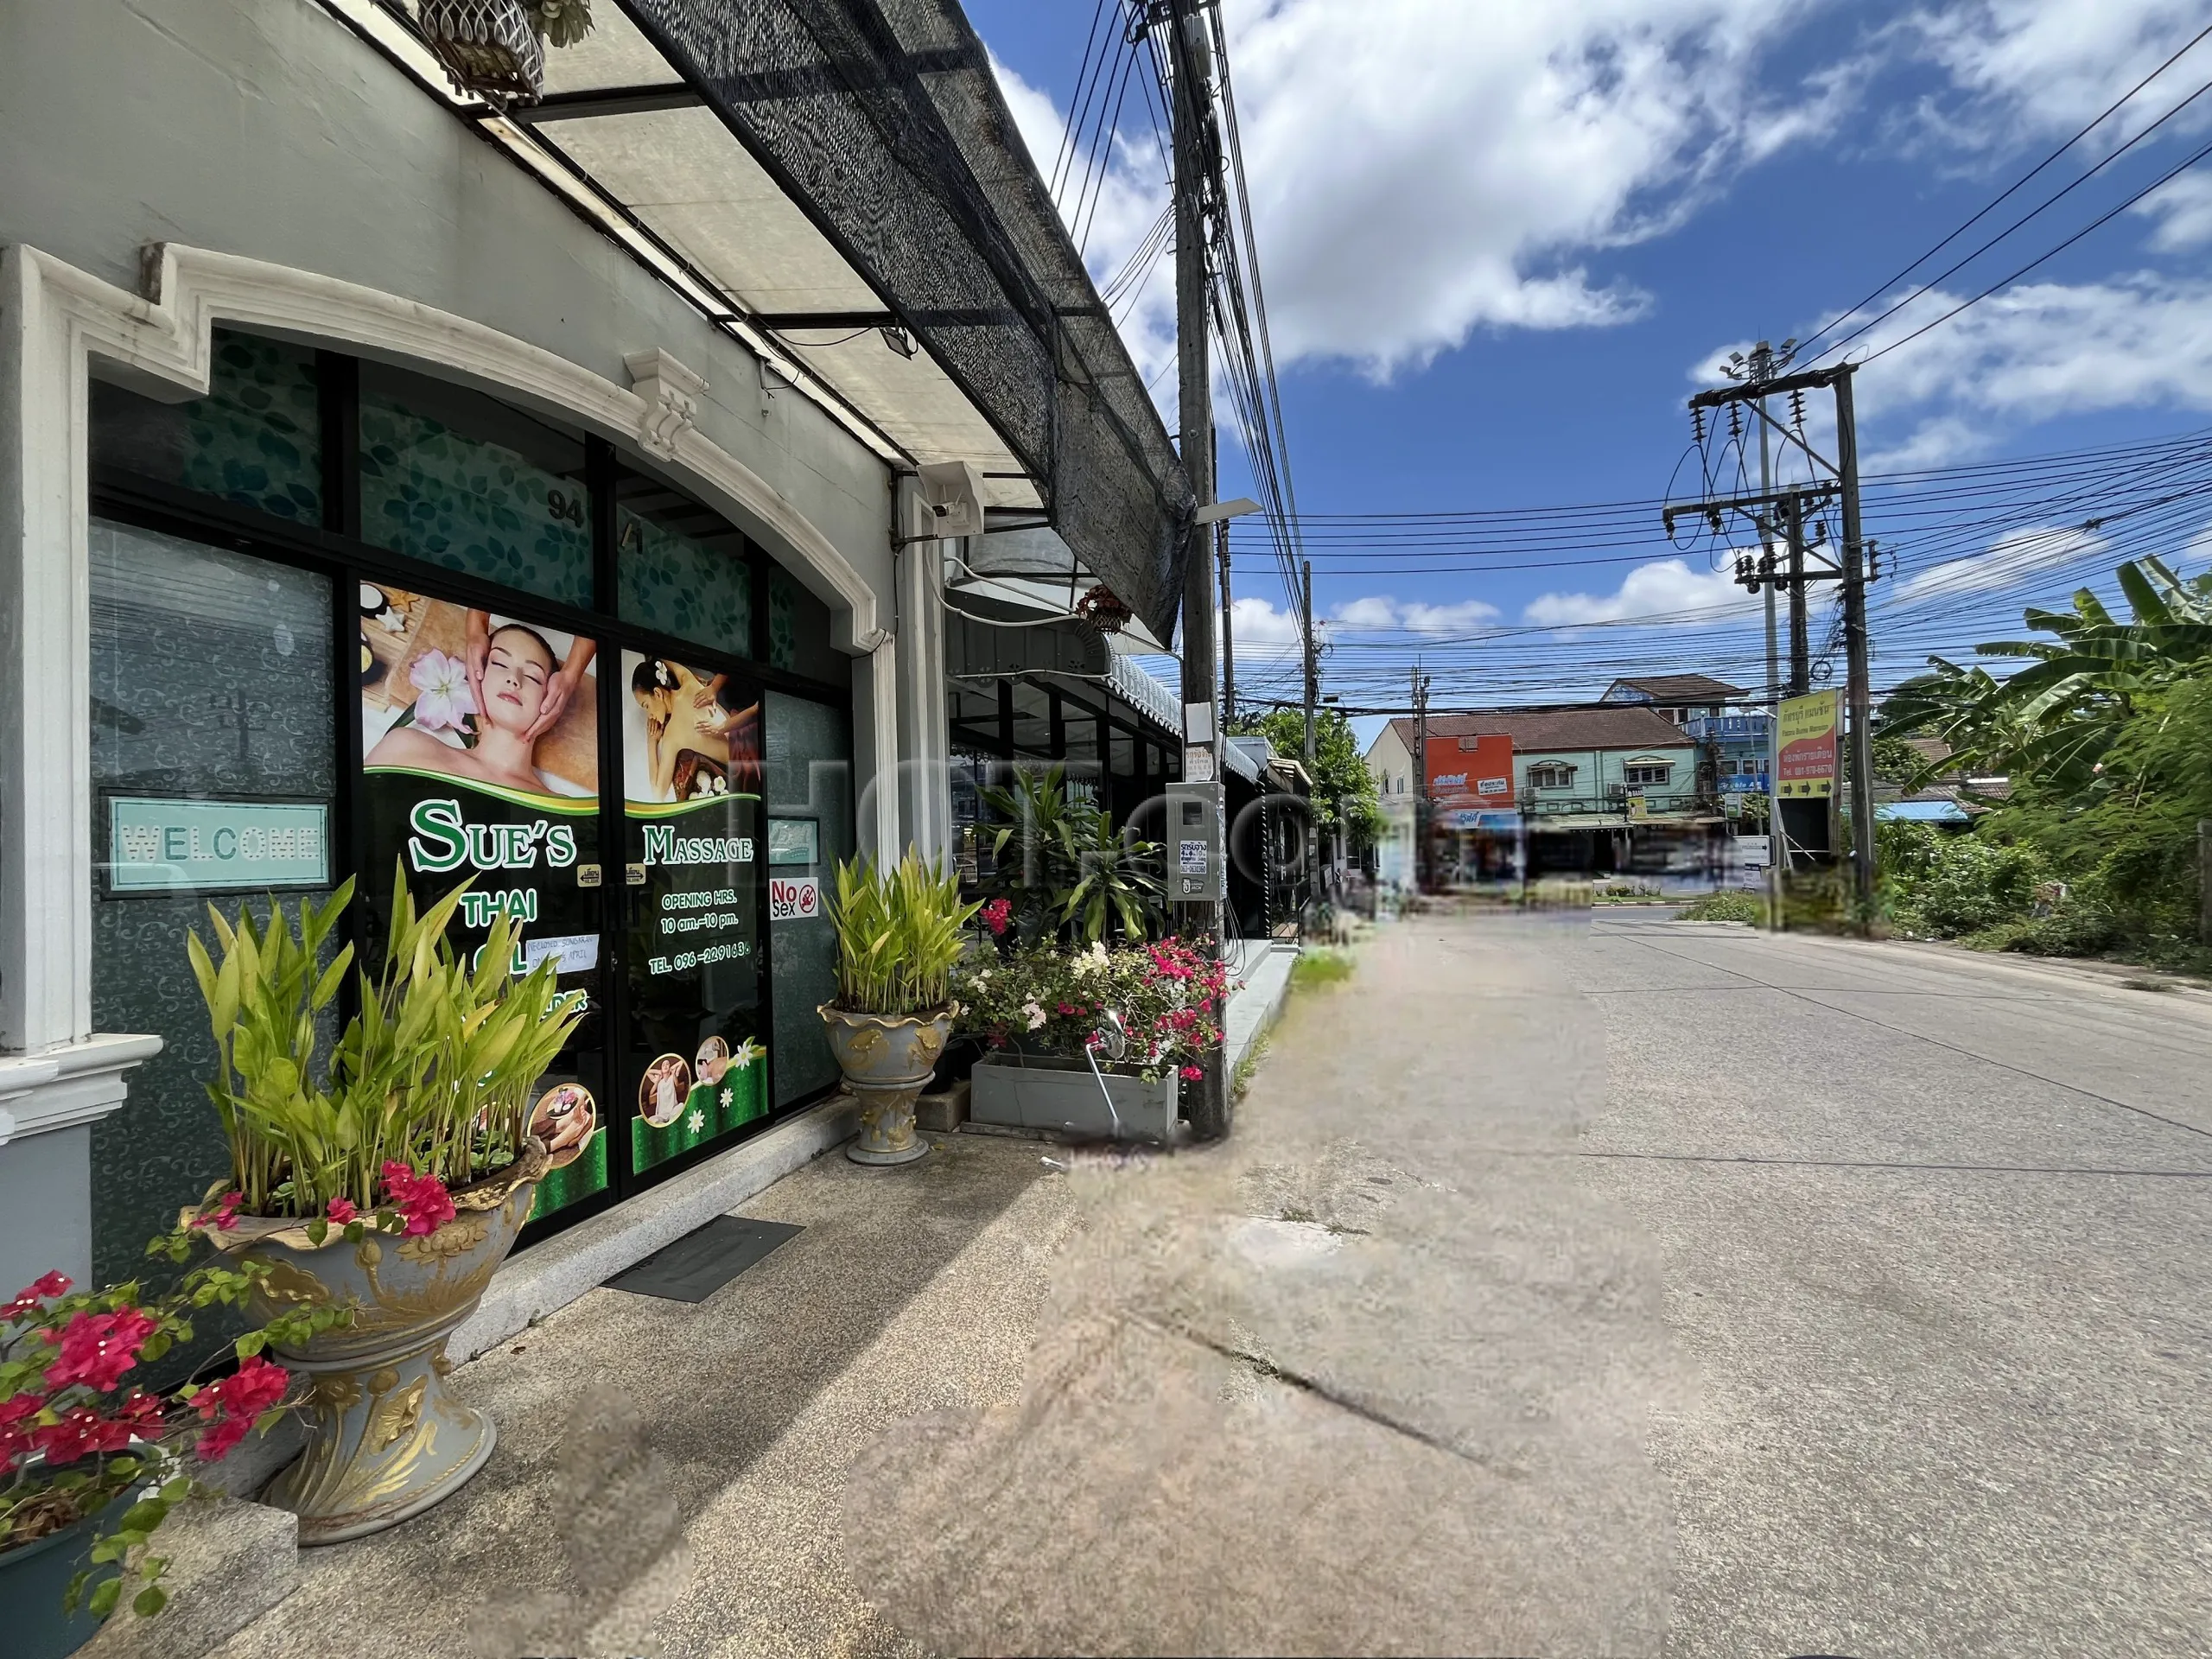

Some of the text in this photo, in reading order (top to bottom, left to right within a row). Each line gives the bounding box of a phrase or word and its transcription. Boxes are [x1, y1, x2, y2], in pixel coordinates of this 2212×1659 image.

[548, 490, 584, 528] 94
[121, 824, 320, 861] WELCOME
[662, 889, 738, 911] OPENING HRS.
[772, 880, 798, 903] No
[460, 888, 537, 928] THAI
[772, 899, 796, 917] Sex
[718, 912, 739, 929] pm.
[649, 957, 672, 975] TEL.
